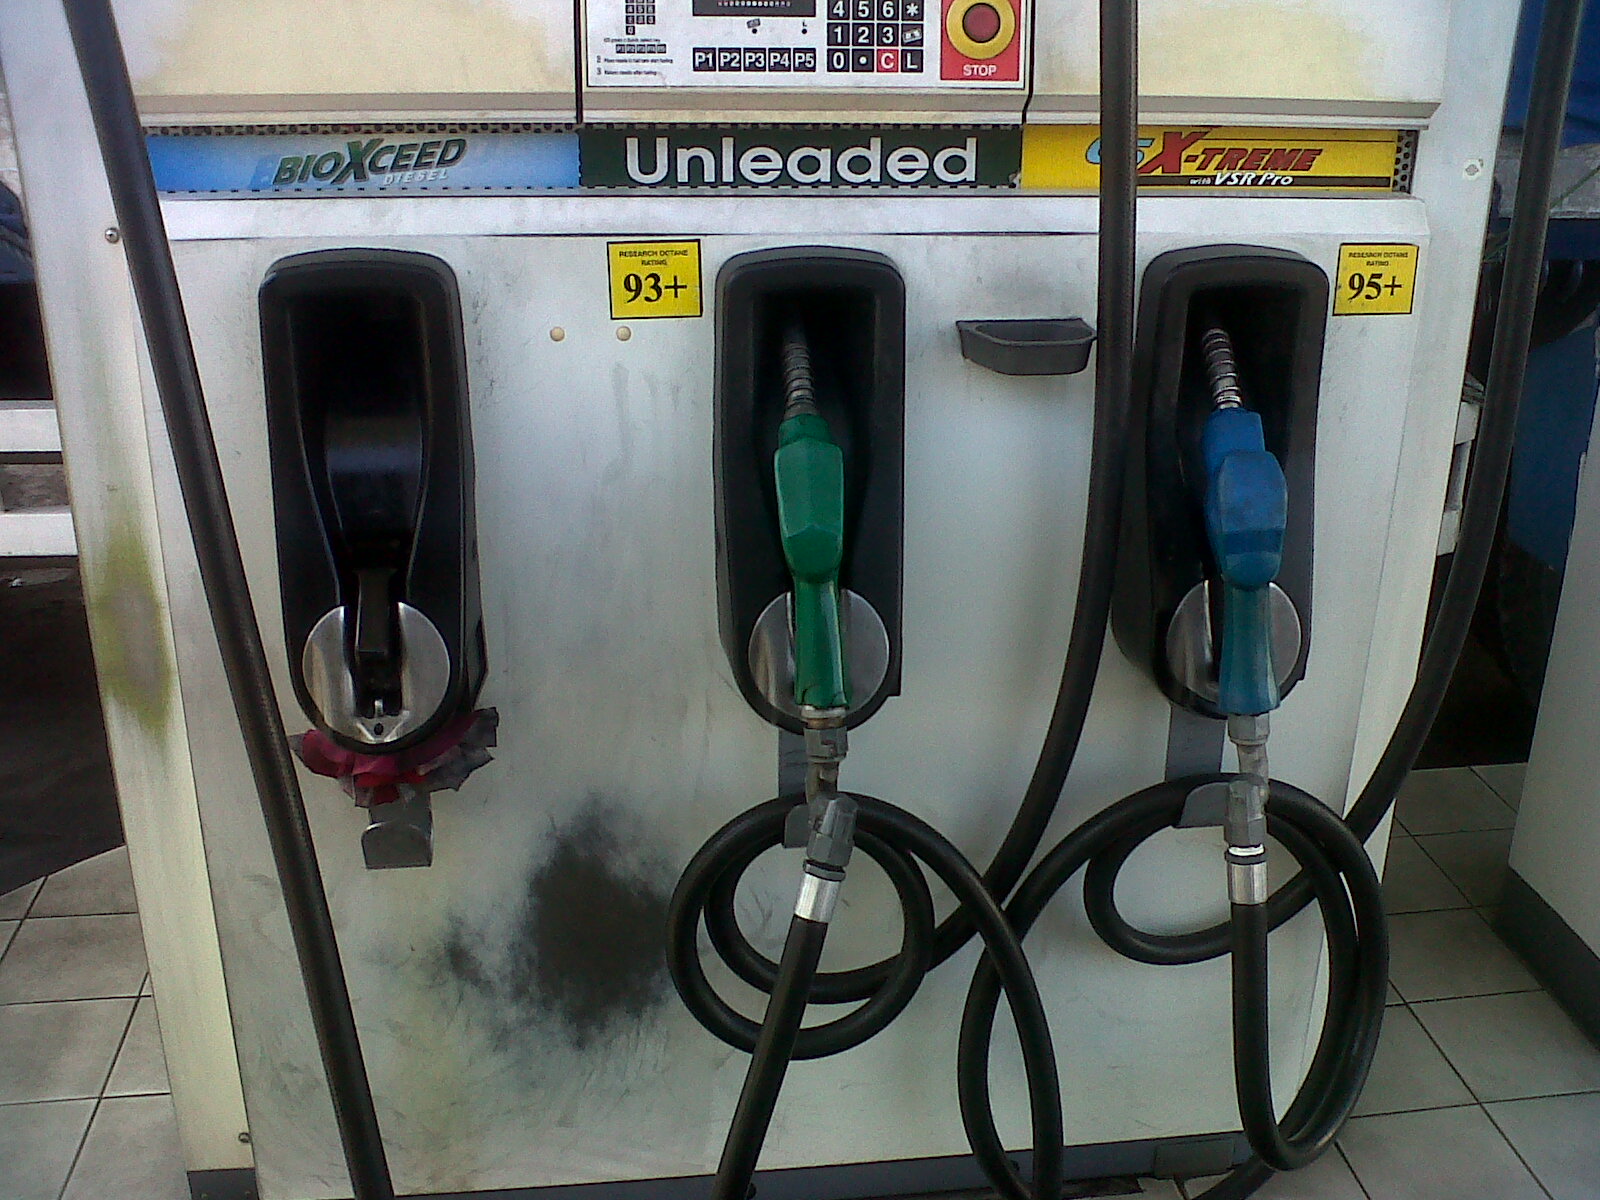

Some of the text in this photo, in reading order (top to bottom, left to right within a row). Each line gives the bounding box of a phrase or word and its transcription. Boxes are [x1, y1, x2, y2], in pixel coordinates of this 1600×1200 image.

[832, 1, 894, 17] 4 5 6
[833, 26, 894, 43] 1 2 3
[694, 52, 815, 68] P1 P2 P3 P4 P5
[832, 52, 918, 69] 0 C L
[962, 64, 997, 76] STOP
[625, 136, 977, 184] Unleaded
[384, 169, 449, 186] DIESEL
[1214, 172, 1256, 186] VSR
[1257, 172, 1293, 186] Pro
[619, 250, 658, 258] RESEARCH
[623, 272, 688, 304] 93+
[1347, 272, 1403, 302] 95+
